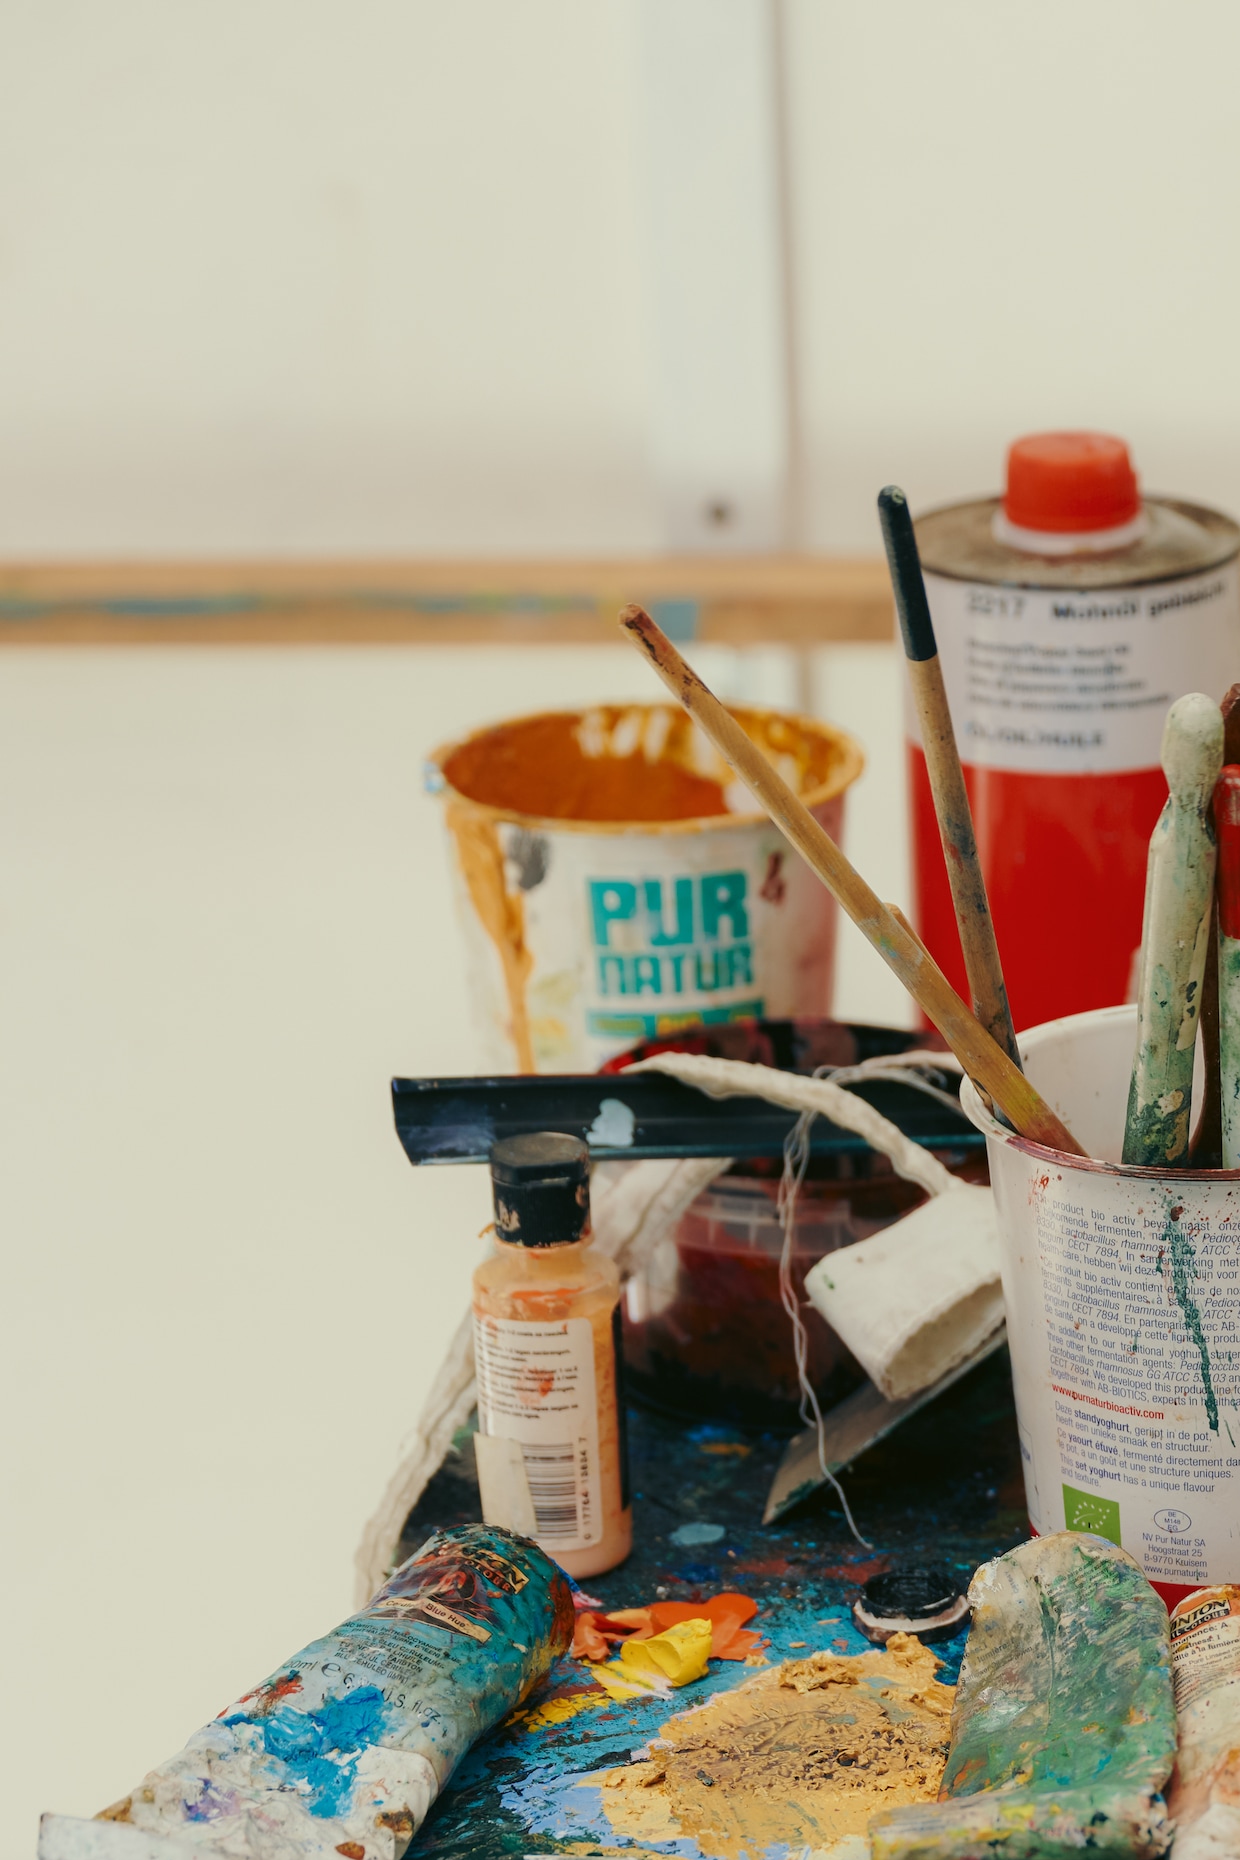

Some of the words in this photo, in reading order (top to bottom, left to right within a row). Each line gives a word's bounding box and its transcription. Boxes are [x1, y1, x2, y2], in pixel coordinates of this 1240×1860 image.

[590, 874, 748, 945] PUR
[1053, 1200, 1084, 1216] product
[1091, 1209, 1105, 1221] bio
[1112, 1215, 1136, 1226] activ
[1143, 1218, 1171, 1229] bevat
[1181, 1220, 1210, 1231] naast
[1061, 1224, 1116, 1246] Lactobacillus
[1121, 1239, 1176, 1255] rhamnosus
[1201, 1245, 1231, 1256] ATCC
[1094, 1222, 1145, 1241] fermenten,
[1152, 1230, 1195, 1244] namelijk
[1068, 1239, 1090, 1253] CECT
[1140, 1255, 1213, 1269] samenwerking
[1220, 1257, 1239, 1267] met
[1084, 1255, 1116, 1270] hebben
[1119, 1263, 1132, 1275] wij
[1135, 1265, 1157, 1276] deze
[1217, 1271, 1238, 1279] voor
[1052, 1383, 1164, 1420] www.purnaturbioactiv.com
[1055, 1400, 1072, 1415] Deze
[1074, 1409, 1131, 1434] standyoghurt,
[1134, 1427, 1163, 1440] gerijpt
[1167, 1429, 1174, 1438] in
[1178, 1430, 1190, 1440] de
[1194, 1432, 1211, 1442] pot,
[1068, 1432, 1092, 1448] yaourt
[1123, 1448, 1162, 1463] fermenté
[1166, 1455, 1222, 1467] directement
[1075, 1423, 1089, 1433] een
[1091, 1427, 1116, 1441] unieke
[1119, 1434, 1148, 1448] smaak
[1151, 1440, 1162, 1449] en
[1165, 1442, 1210, 1452] structuur.
[1075, 1460, 1087, 1471] set
[1089, 1466, 1121, 1482] yoghurt
[1123, 1473, 1138, 1485] has
[1149, 1479, 1180, 1491] unique
[1183, 1482, 1215, 1492] flavour
[1100, 1455, 1117, 1468] goût
[1130, 1462, 1146, 1472] une
[1149, 1465, 1190, 1478] structure
[1194, 1470, 1233, 1480] uniques.
[1142, 1532, 1154, 1542] NV
[1155, 1534, 1168, 1543] Pur
[1170, 1537, 1192, 1546] Natur
[1194, 1538, 1206, 1547] SA
[1148, 1543, 1189, 1556] Hoogstraat
[1191, 1548, 1203, 1557] 25
[464, 1559, 512, 1592] OLOUR
[1144, 1553, 1174, 1565] B-9770
[1175, 1557, 1207, 1568] Kruisem
[425, 1602, 447, 1617] Blue
[448, 1613, 466, 1628] Hue
[1170, 1599, 1228, 1632] INTON
[1171, 1625, 1218, 1649] manence:
